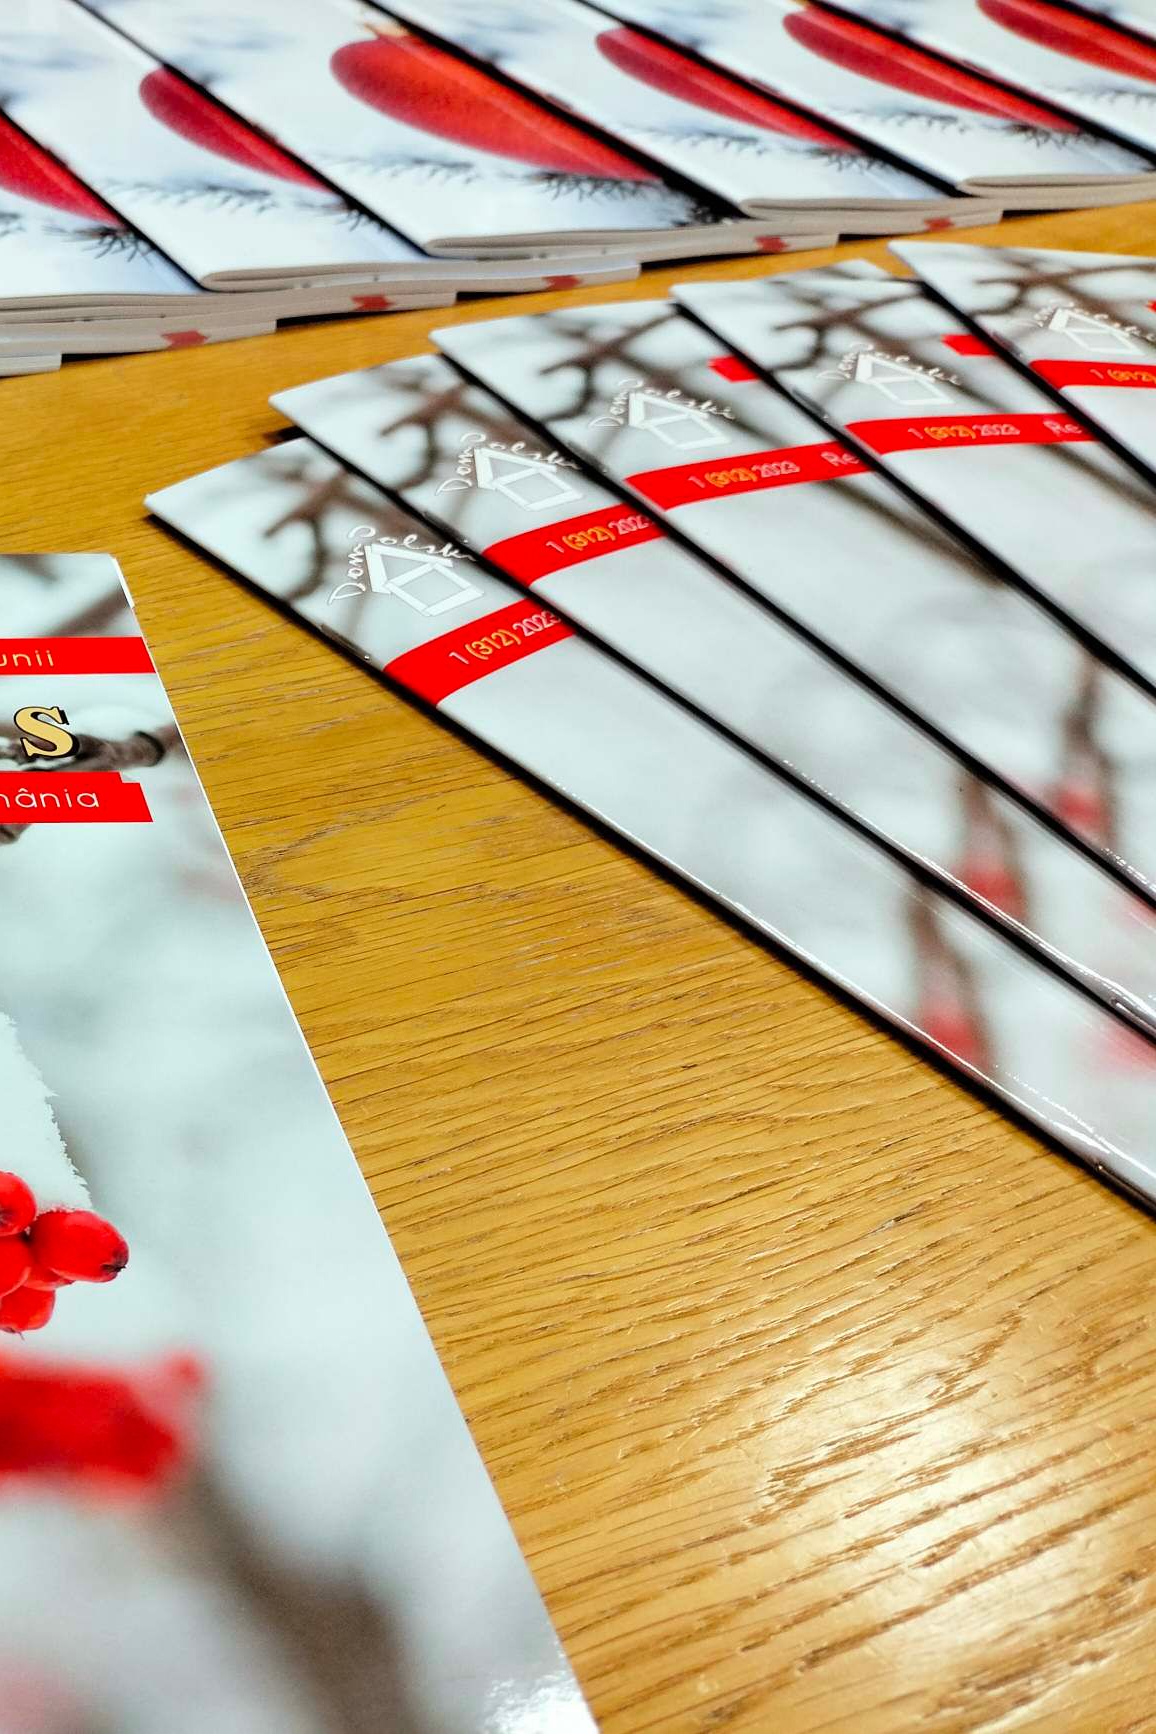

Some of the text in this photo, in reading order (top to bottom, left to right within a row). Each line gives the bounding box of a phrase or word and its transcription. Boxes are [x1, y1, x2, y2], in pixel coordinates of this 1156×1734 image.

[908, 427, 924, 440] 1
[435, 445, 474, 496] Dom
[687, 475, 706, 489] 1
[545, 514, 654, 553] 1 (312) 202
[327, 543, 367, 606] Dom
[448, 650, 470, 665] 1
[464, 628, 522, 660] (312)
